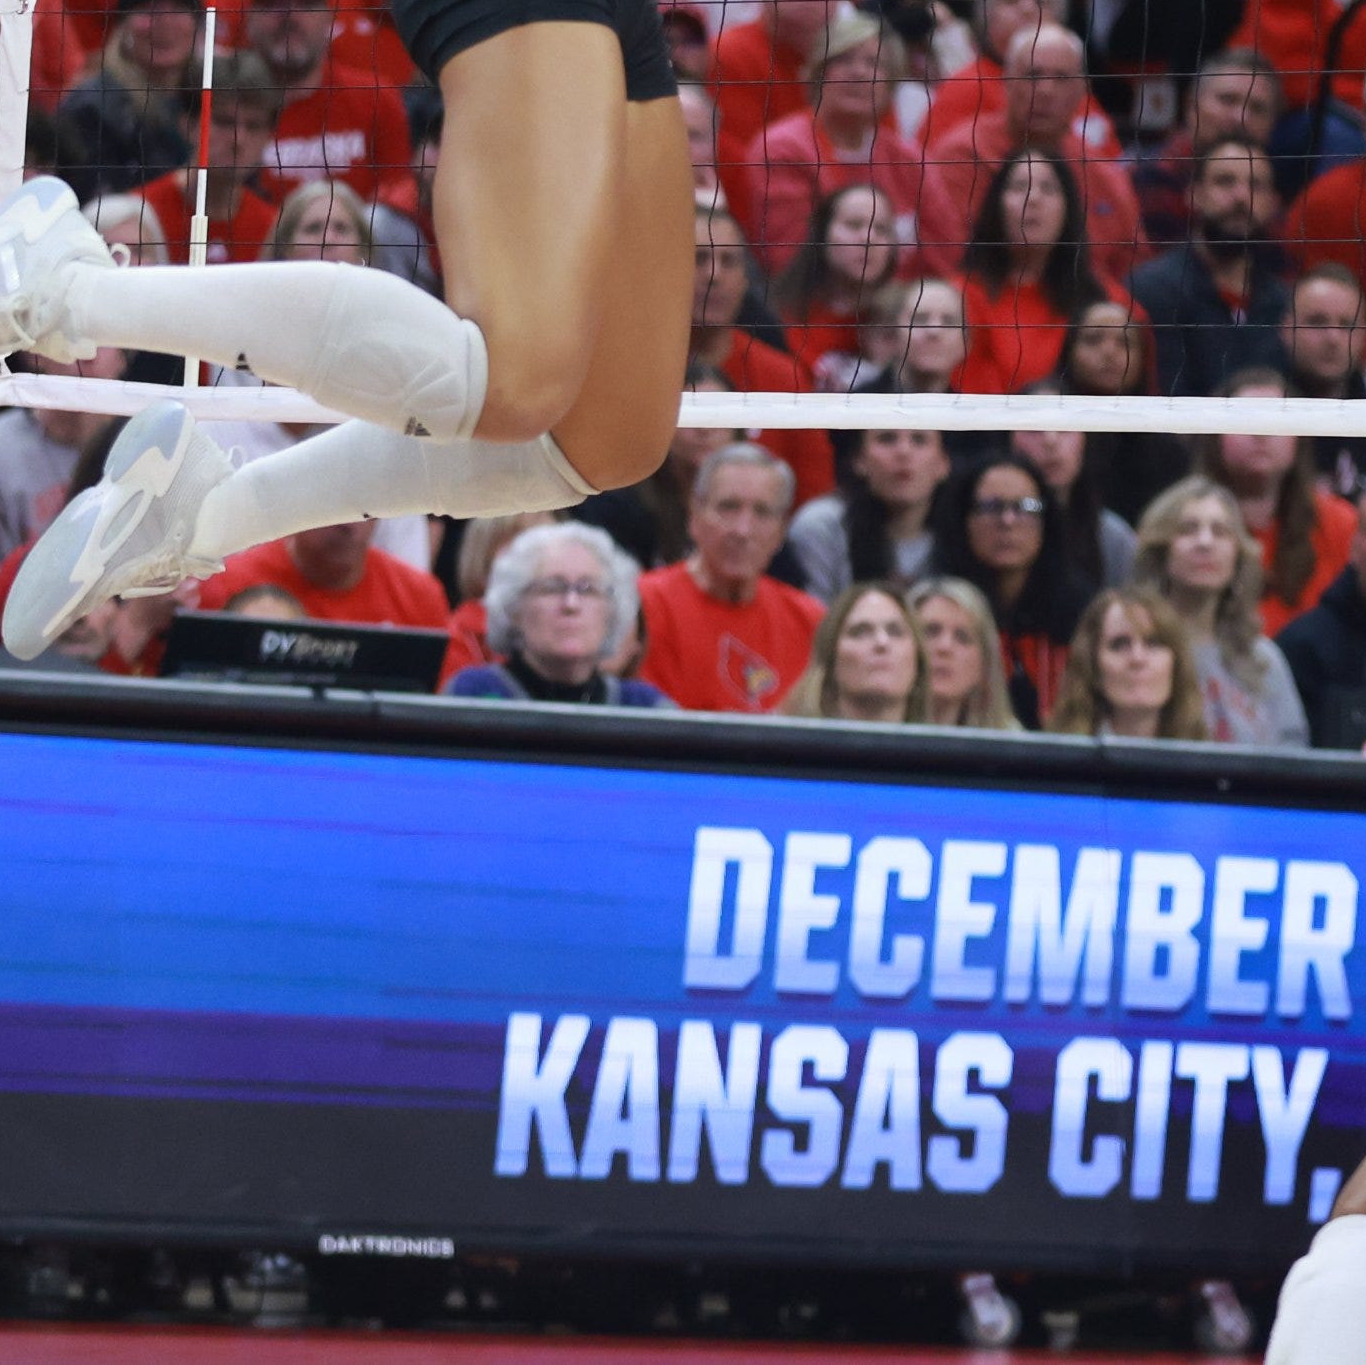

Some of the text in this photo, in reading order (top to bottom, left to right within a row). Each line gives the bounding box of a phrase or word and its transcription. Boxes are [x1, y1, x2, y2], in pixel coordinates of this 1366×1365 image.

[682, 825, 1360, 1022] DECEMBER
[494, 1011, 1014, 1195] KANSAS
[1047, 1035, 1342, 1222] CITY,
[318, 1234, 455, 1258] DAKTRONICS
